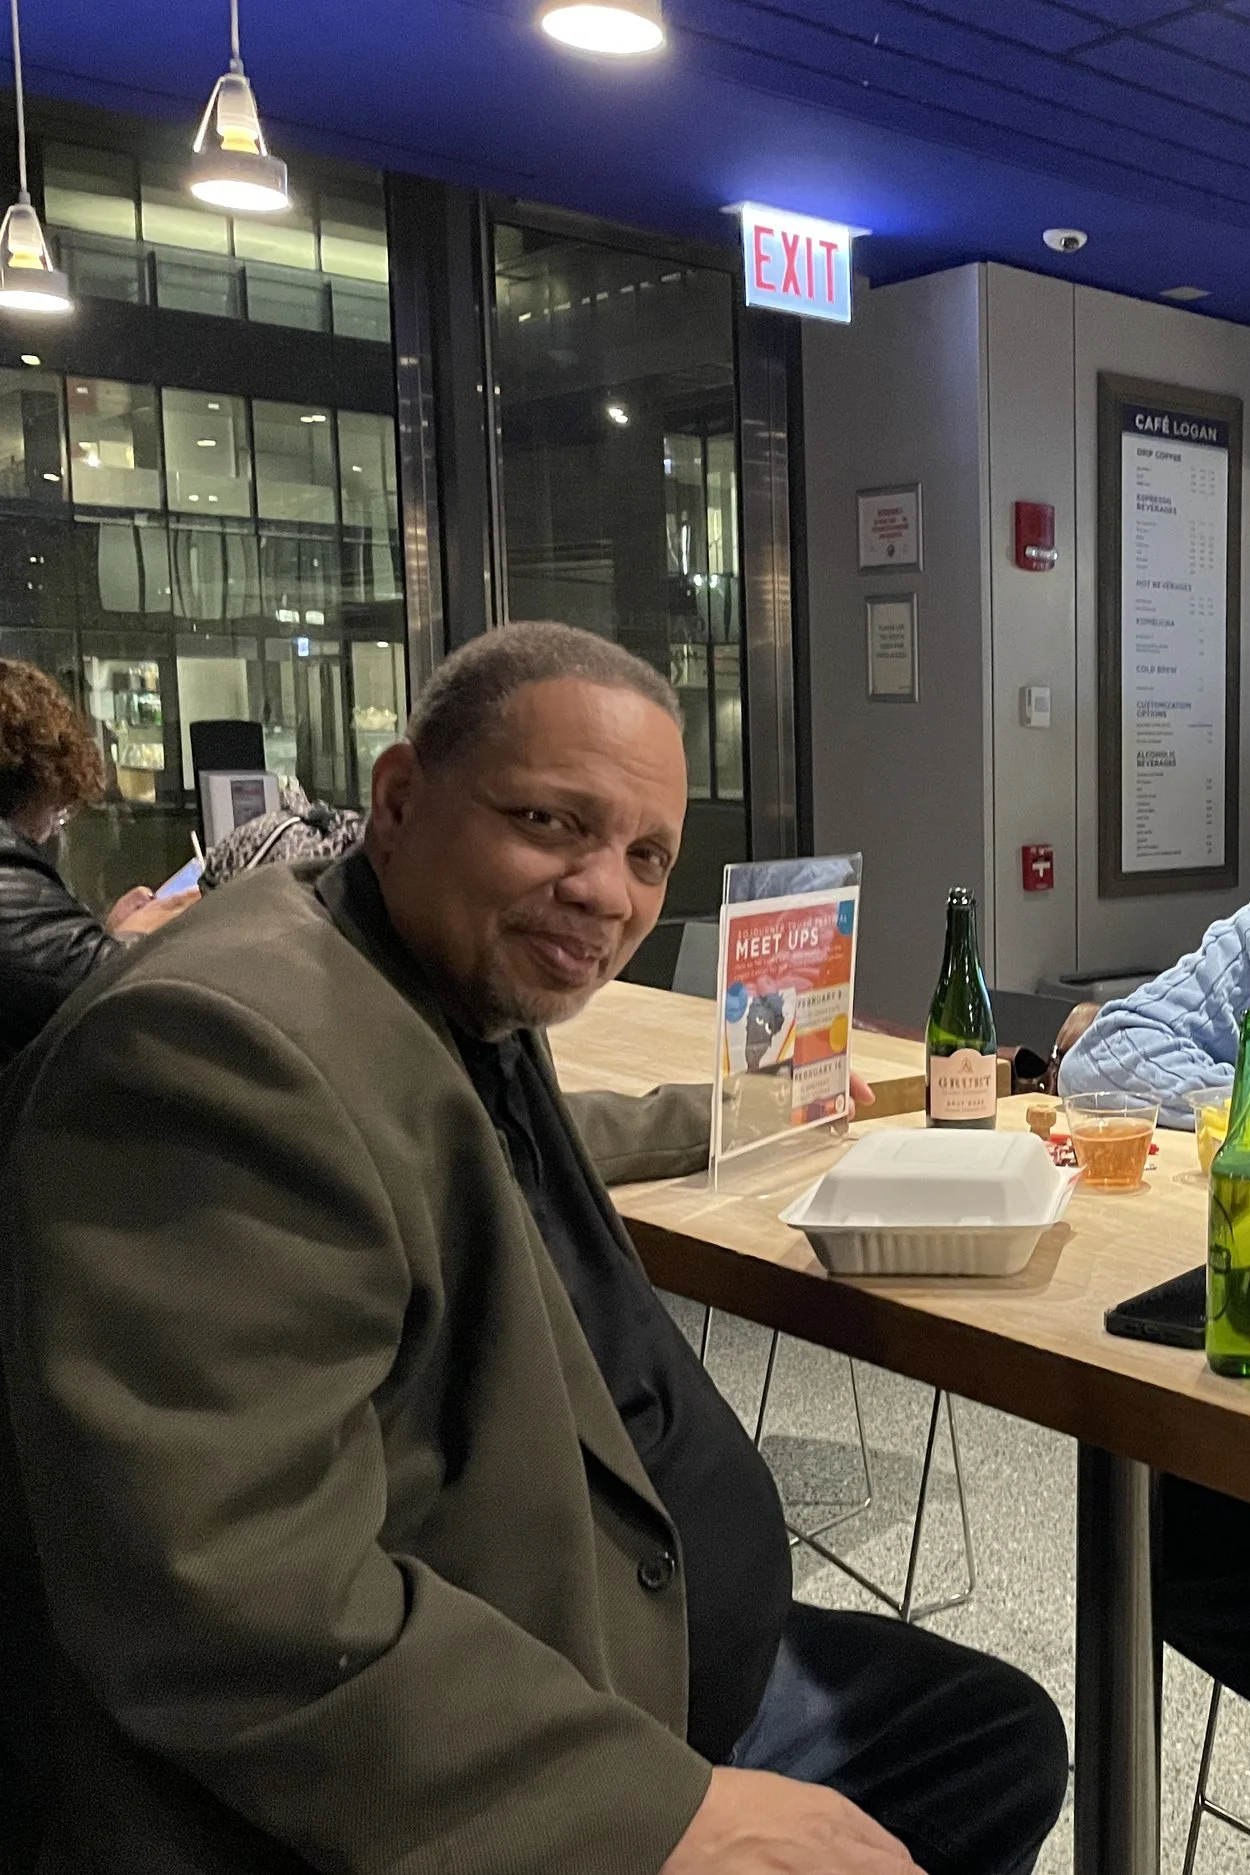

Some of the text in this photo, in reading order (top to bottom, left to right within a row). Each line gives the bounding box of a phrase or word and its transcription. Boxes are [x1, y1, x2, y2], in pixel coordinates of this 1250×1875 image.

[754, 225, 839, 304] EXIT
[1135, 413, 1217, 441] CAFÉ LOGAN
[1136, 759, 1177, 768] BEVERAGES
[736, 926, 819, 961] MEET UPS
[797, 991, 836, 1009] FEBRUARY
[794, 1063, 832, 1081] FEBRUARY
